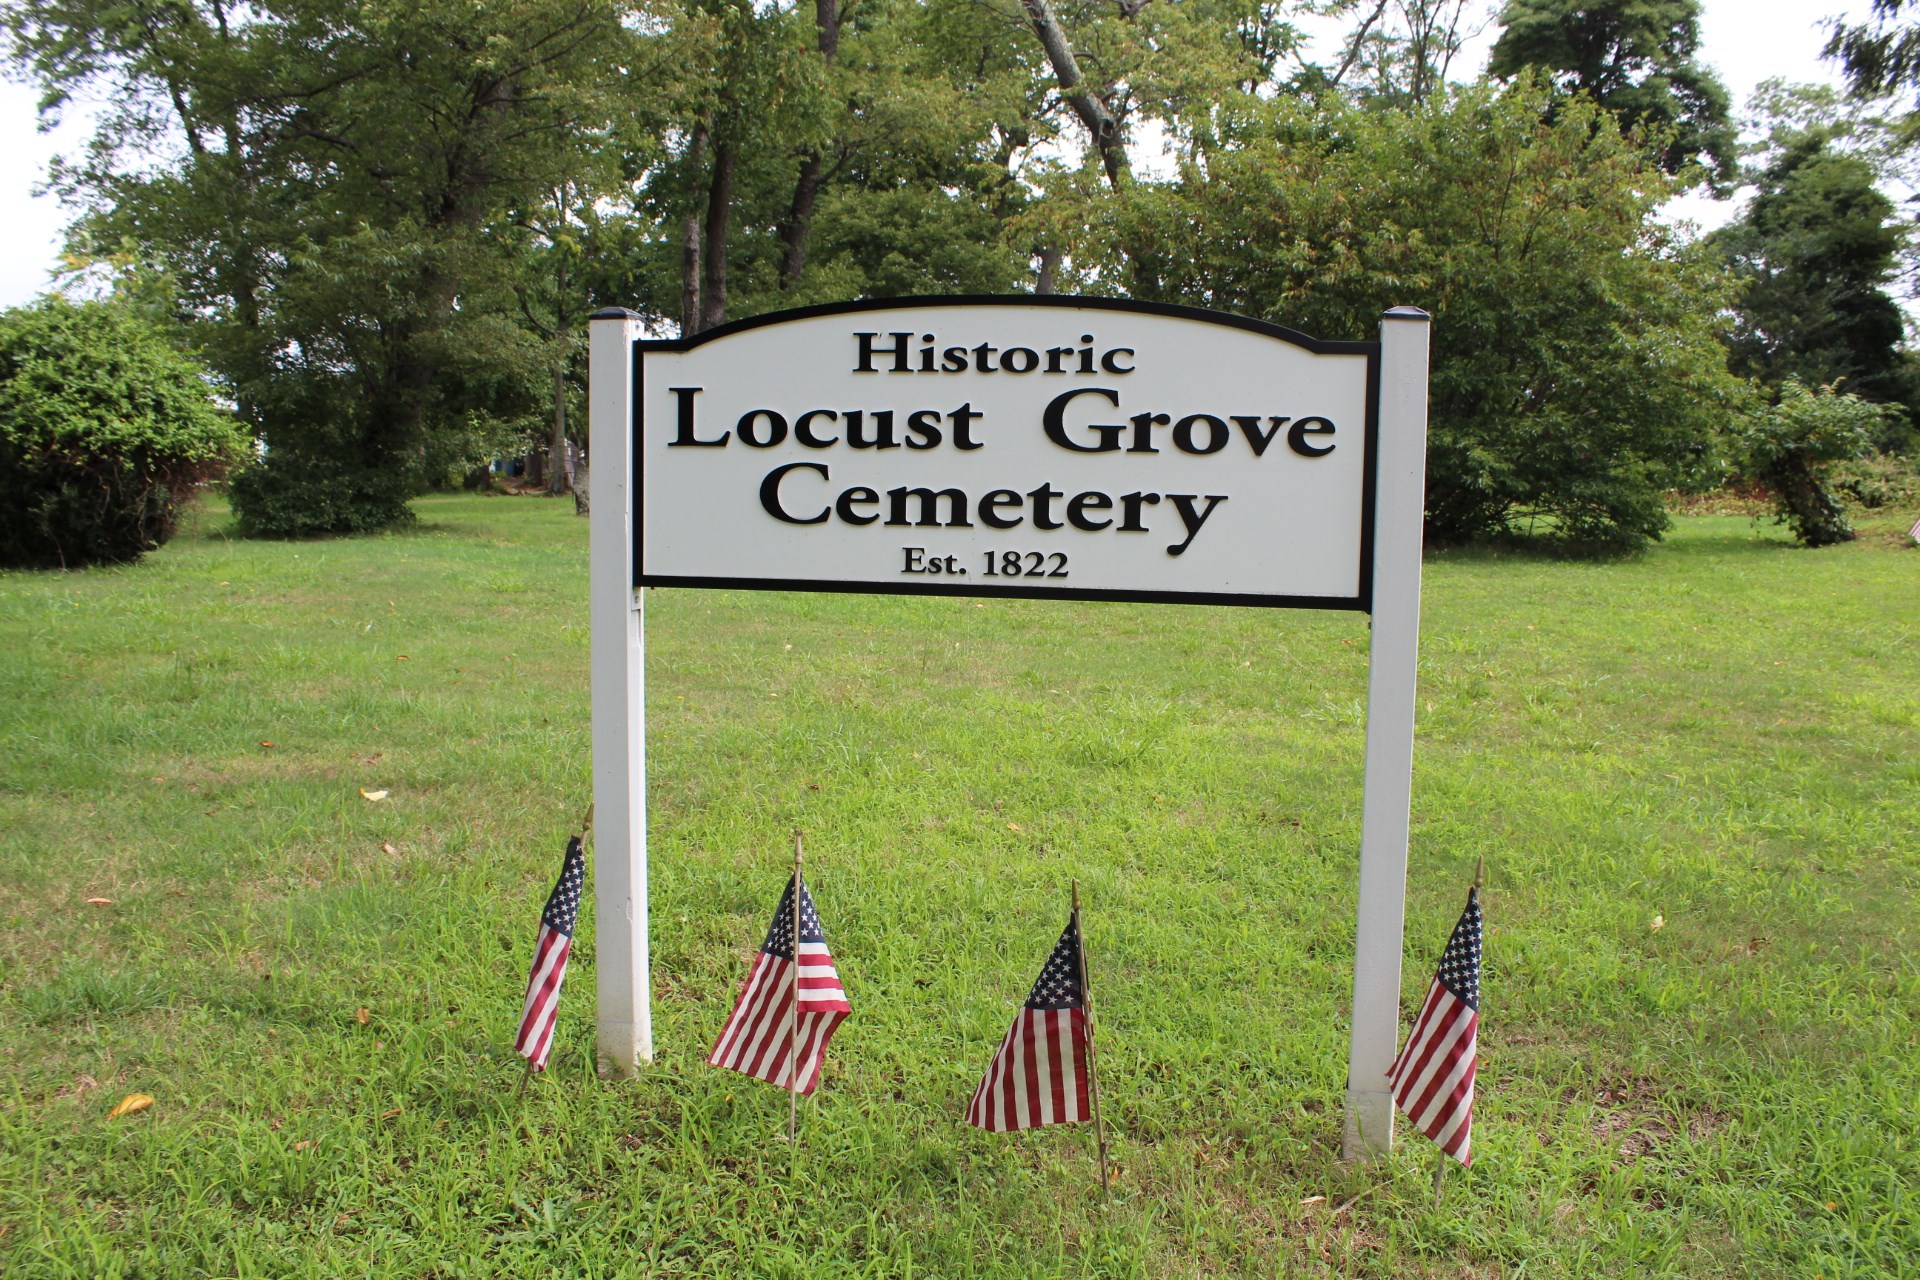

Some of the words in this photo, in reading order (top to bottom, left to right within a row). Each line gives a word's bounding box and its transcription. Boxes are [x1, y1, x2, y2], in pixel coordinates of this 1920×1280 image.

[853, 333, 1135, 376] Historic
[668, 388, 984, 451] Locust
[1043, 388, 1336, 458] Grove
[760, 462, 1228, 558] Cemetery
[901, 547, 967, 575] Est.
[983, 551, 1068, 577] 1822
